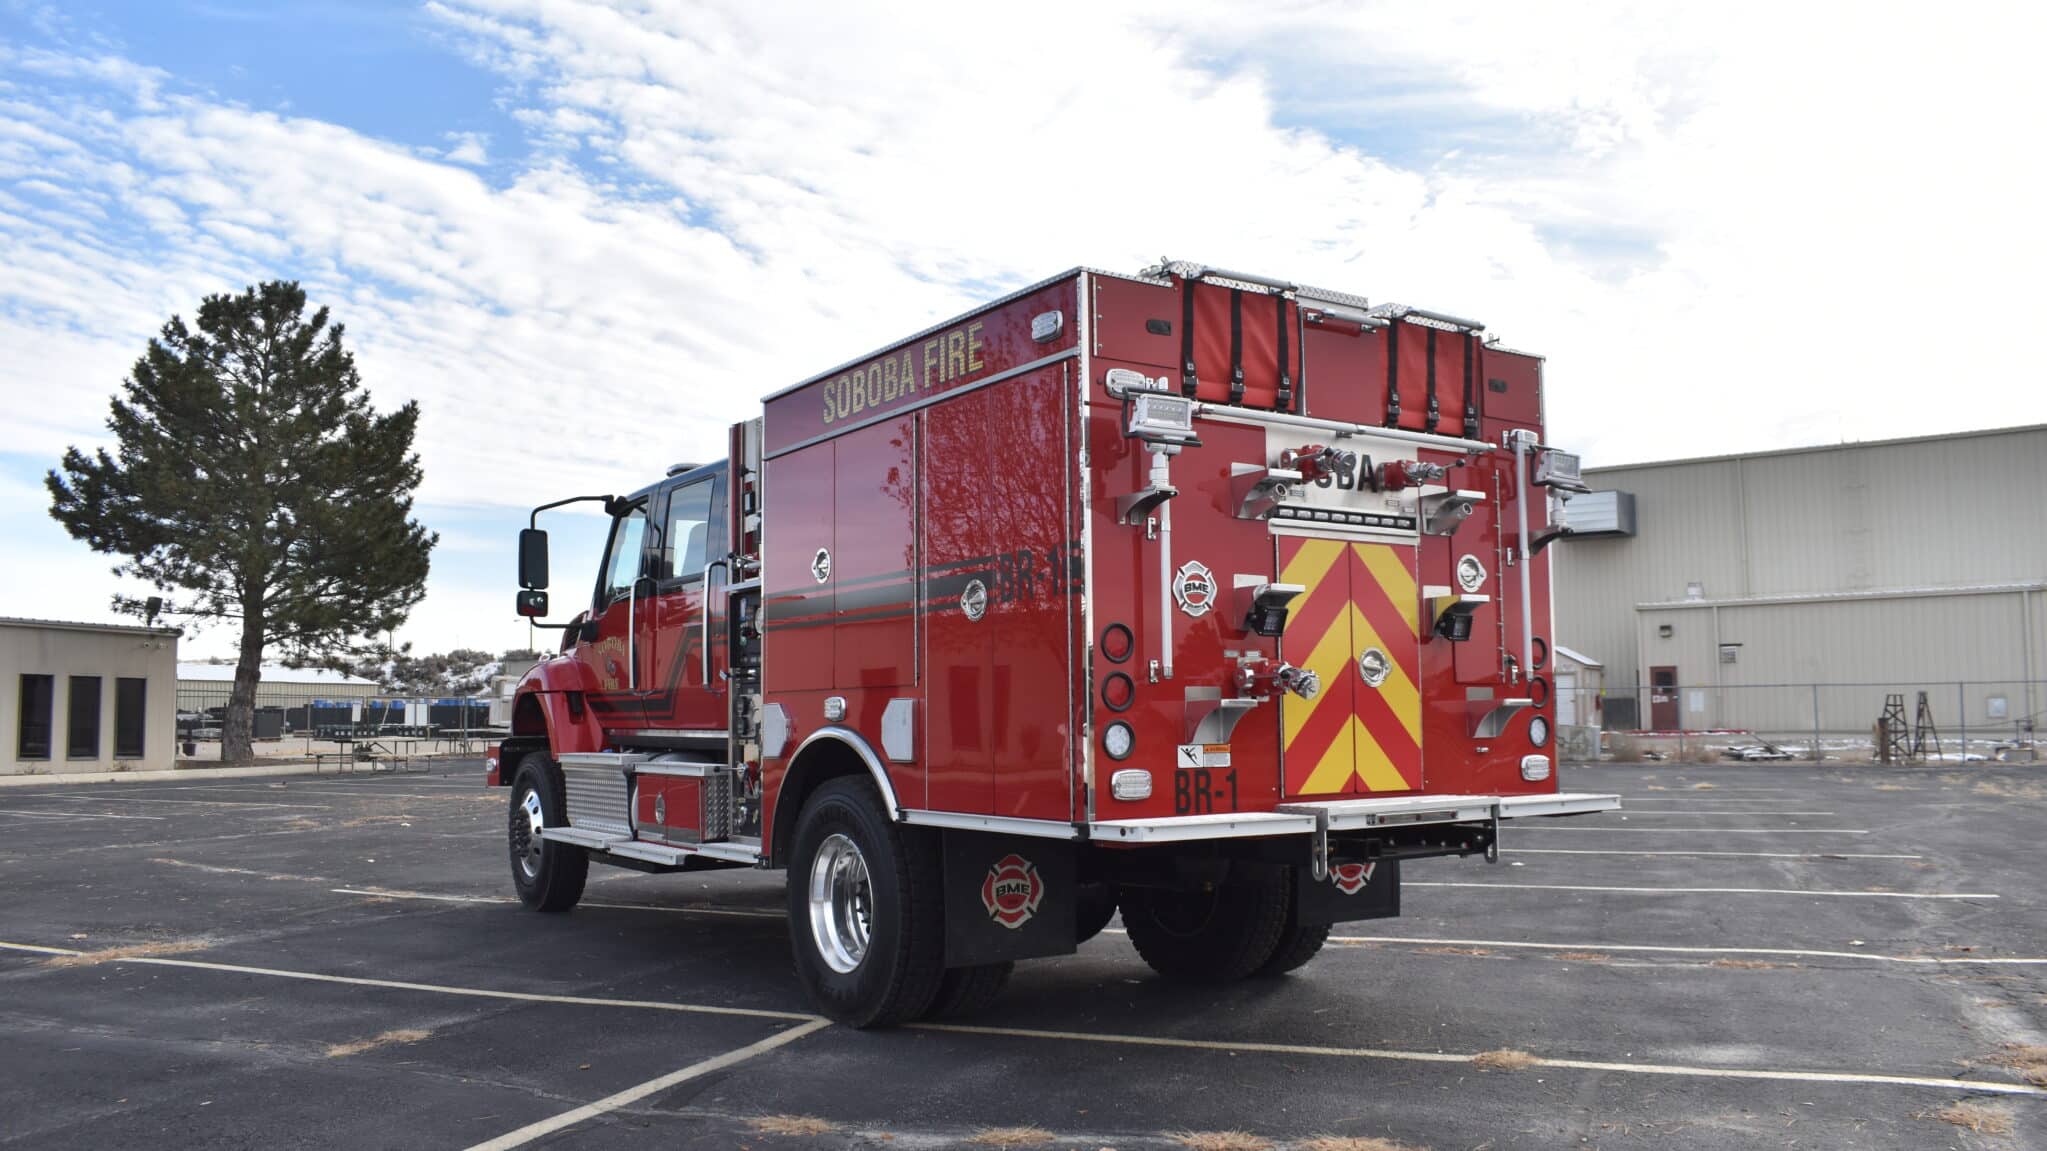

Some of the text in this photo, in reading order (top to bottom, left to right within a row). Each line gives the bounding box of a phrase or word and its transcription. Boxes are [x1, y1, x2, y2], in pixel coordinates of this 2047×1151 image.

[823, 321, 984, 424] SOBOBA FIRE
[1000, 544, 1059, 602] BR-1
[1184, 582, 1209, 594] BME
[1174, 768, 1238, 814] BR-1
[996, 883, 1030, 897] BME
